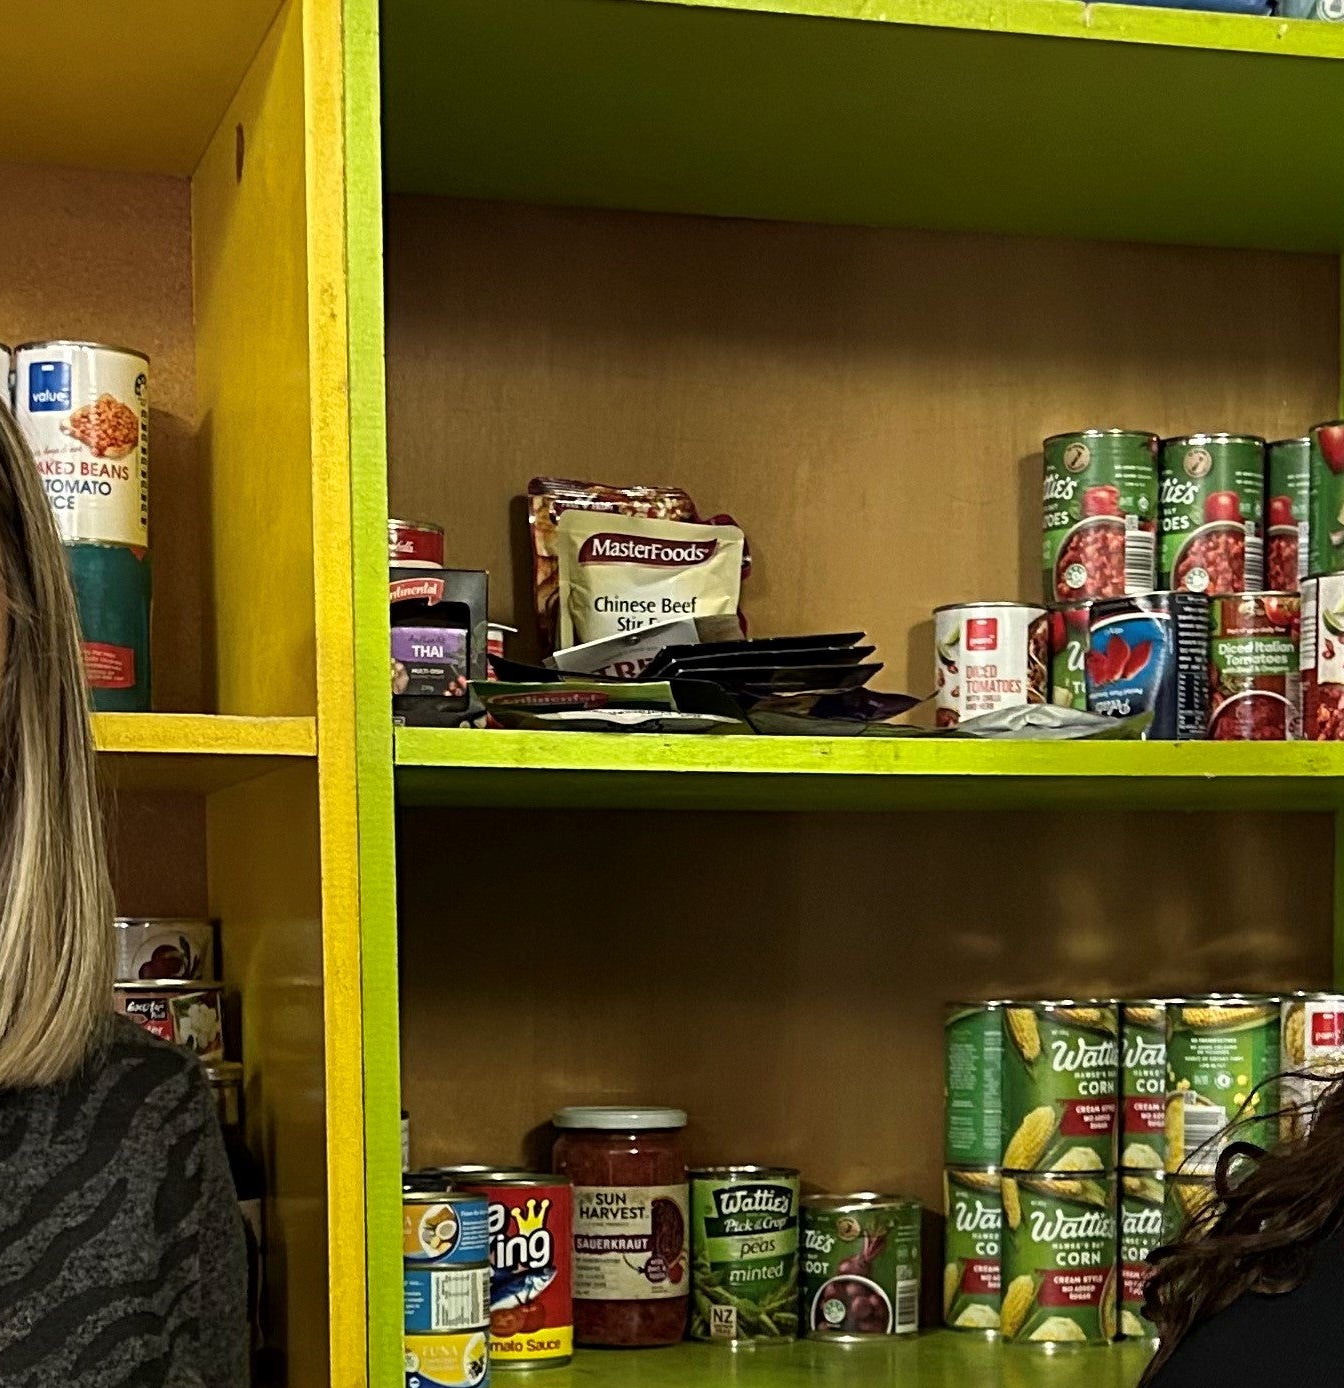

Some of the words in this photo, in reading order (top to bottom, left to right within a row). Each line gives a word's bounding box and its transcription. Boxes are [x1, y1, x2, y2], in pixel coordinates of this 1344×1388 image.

[80, 462, 130, 481] BEANS
[45, 478, 112, 496] TOMATO
[591, 538, 707, 563] MasterFoods
[593, 595, 657, 614] Chinese
[661, 596, 698, 615] Beef
[411, 644, 444, 659] THAI
[1217, 640, 1253, 656] Diced
[1254, 640, 1296, 656] Italian
[1225, 652, 1290, 667] Tomatoes
[965, 664, 998, 679] DICED
[964, 679, 1023, 695] TOMATOES
[595, 1192, 627, 1206] SUN
[719, 1188, 791, 1215] Wattie's
[578, 1206, 647, 1220] HARVEST
[722, 1217, 754, 1234] Pick
[575, 1238, 649, 1251] SAUERKRAUT
[739, 1238, 777, 1259] peas
[1055, 1250, 1102, 1267] CORN
[728, 1261, 785, 1283] minted
[1053, 1275, 1081, 1285] CREAM
[712, 1308, 734, 1324] NZ
[526, 1339, 562, 1352] Sauce
